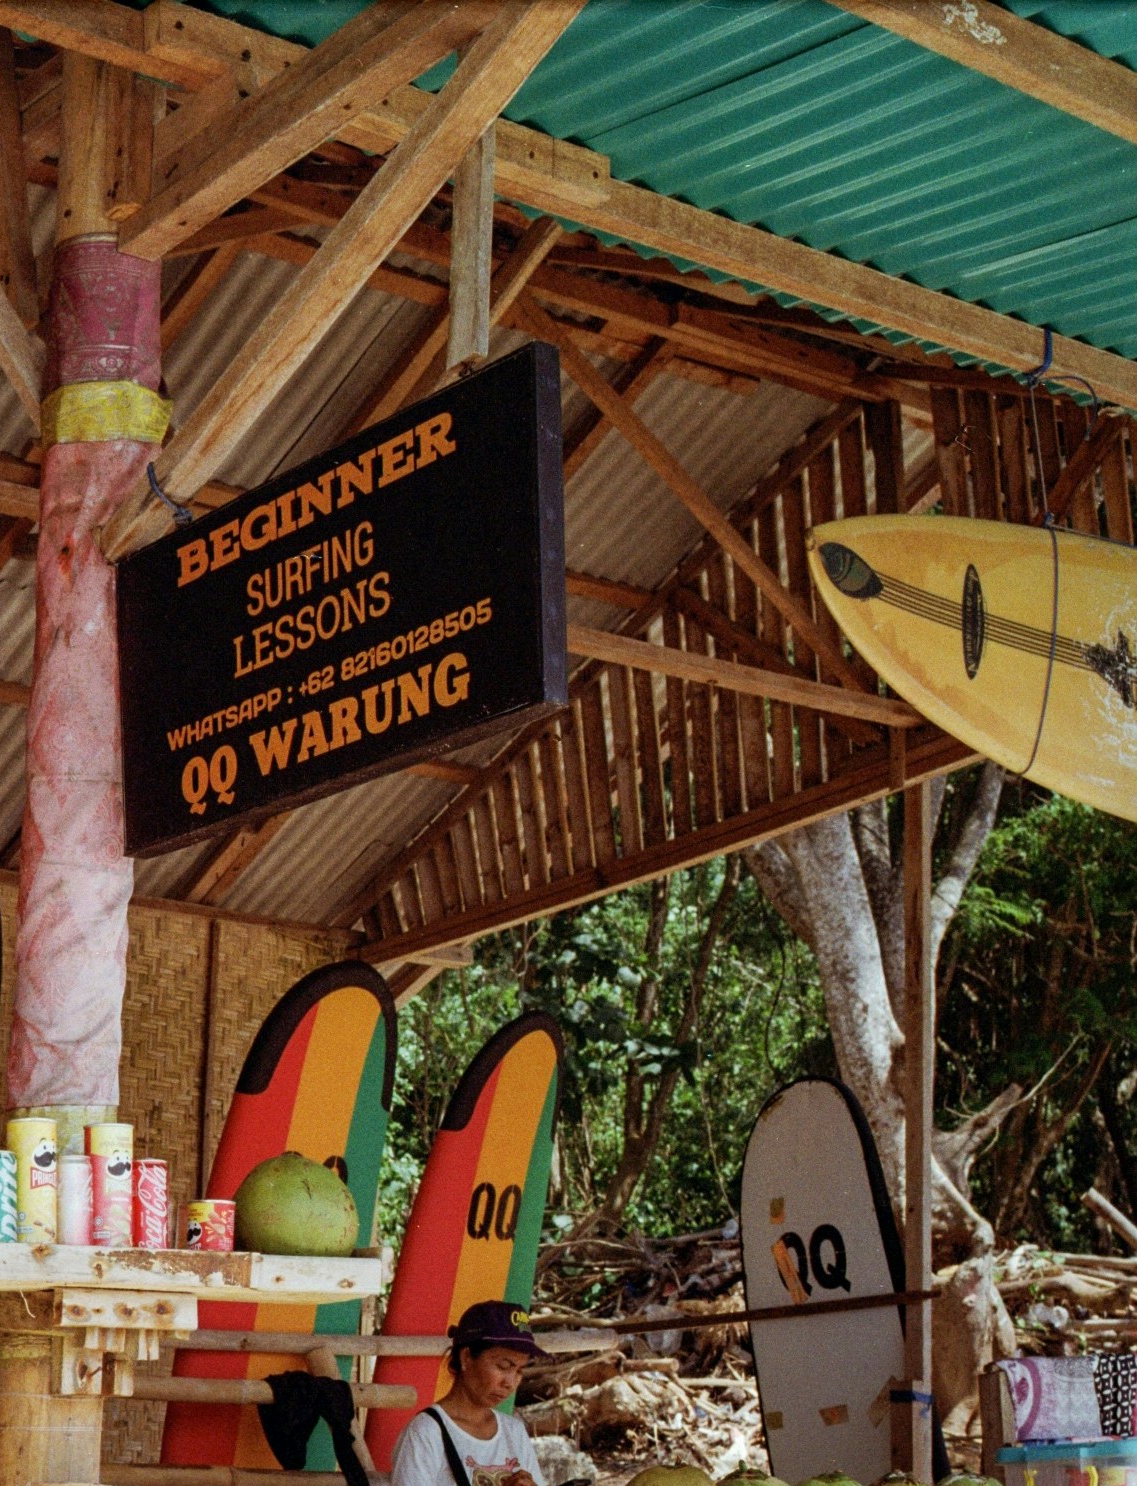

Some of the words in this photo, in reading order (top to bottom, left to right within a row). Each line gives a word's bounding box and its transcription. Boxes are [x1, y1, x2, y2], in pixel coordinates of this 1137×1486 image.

[176, 412, 457, 588] BEGINNER
[233, 571, 392, 679] LESSONS
[246, 520, 375, 617] SURFING
[167, 685, 282, 752] WHATSAPP
[298, 666, 335, 698] +62
[340, 597, 494, 683] 82160128505
[181, 747, 238, 815] QQ
[249, 652, 472, 778] WARUNG
[467, 1181, 524, 1242] QQ
